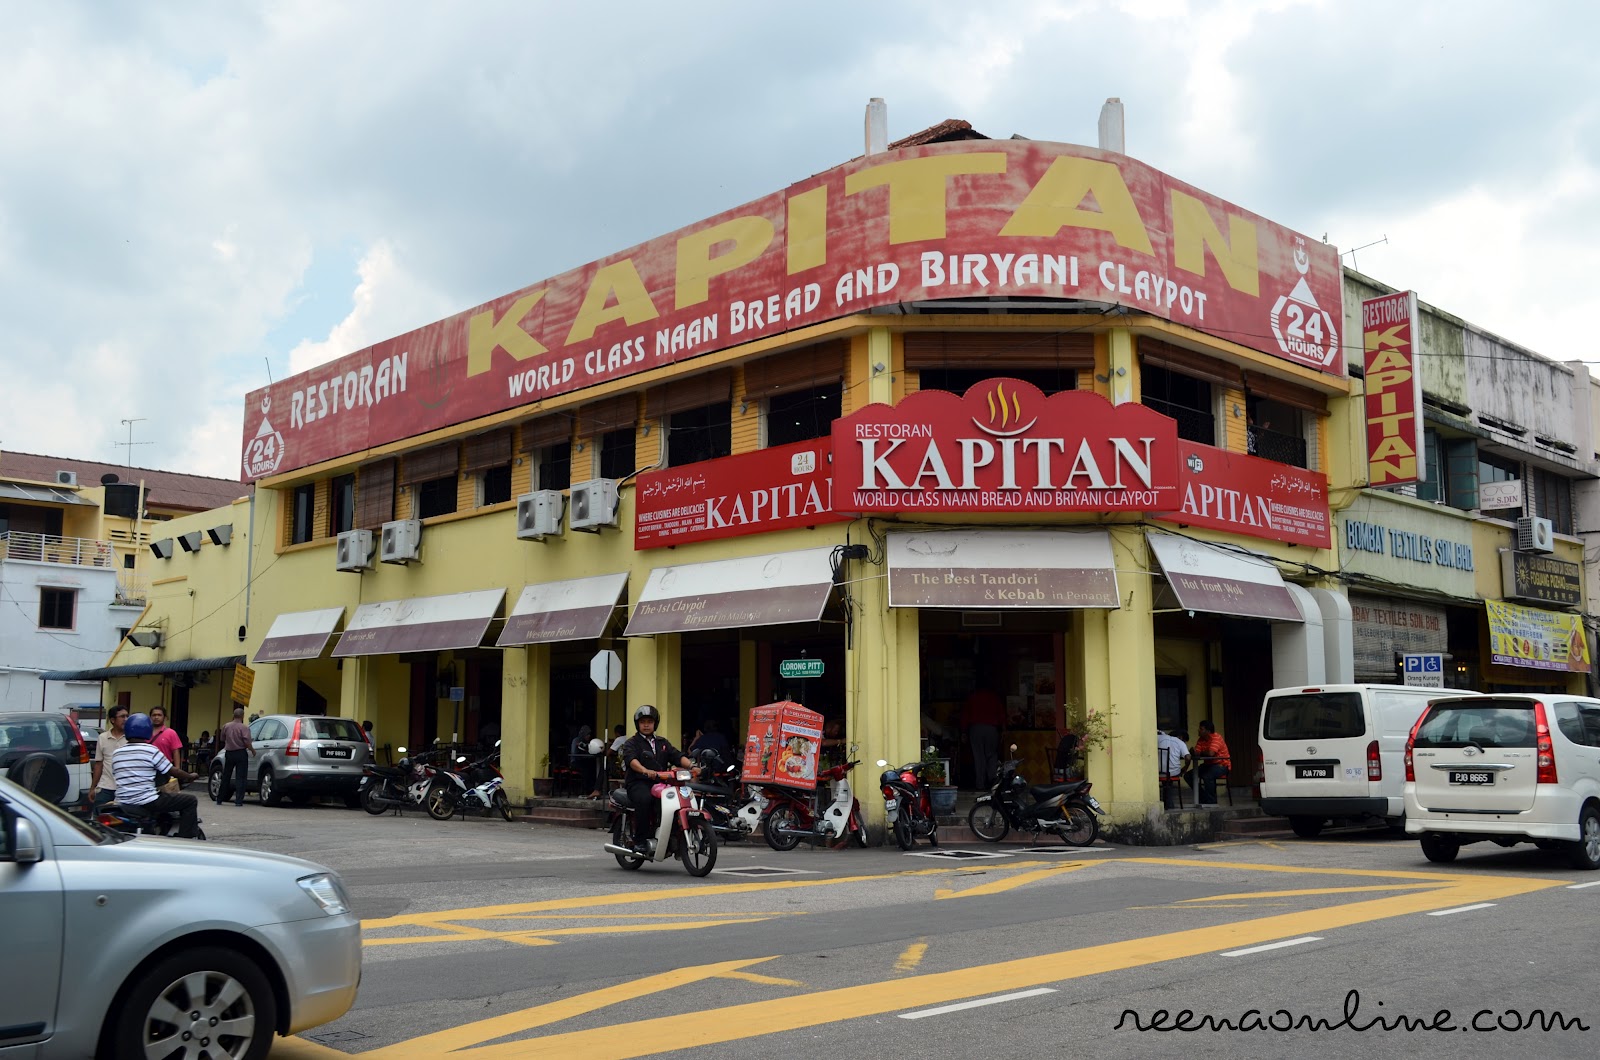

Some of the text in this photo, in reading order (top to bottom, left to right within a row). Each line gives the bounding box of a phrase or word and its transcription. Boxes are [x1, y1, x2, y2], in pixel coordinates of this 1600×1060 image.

[467, 152, 1260, 378] KAPITAN
[1364, 295, 1410, 329] RESTORAN
[508, 250, 1207, 398] WORLD CLASS NAAN BREAD AND BIRYANI CLAYPOT
[1286, 303, 1323, 345] 24
[1287, 335, 1325, 361] HOURS
[290, 352, 408, 430] RESTORAN
[1364, 323, 1417, 484] KAPITAN
[855, 424, 932, 438] RESTORAN
[252, 436, 275, 463] 24
[252, 459, 275, 474] HOURS
[797, 454, 808, 465] 24
[856, 436, 1156, 490] KAPITAN
[853, 491, 1159, 507] WORLD CLASS NAAN BREAD AND BRIYANI CLAYPOT
[1180, 481, 1272, 529] APITAN
[672, 508, 681, 517] ARE
[1346, 519, 1385, 555] BOMBAY
[1389, 528, 1432, 564] TEXTILES
[1435, 538, 1455, 568] SDN.
[1455, 543, 1474, 572] BHD.
[911, 573, 1039, 585] The Best Tandori
[1181, 578, 1244, 595] Hot from Wok
[984, 589, 1110, 602] & Kebab in Penang
[640, 599, 707, 615] The 1st Claypot
[684, 611, 718, 626] Biryani
[1374, 609, 1407, 626] TEXTILES
[526, 625, 577, 639] Western Food
[783, 662, 821, 670] LORONG PITT
[1469, 773, 1488, 782] 8665
